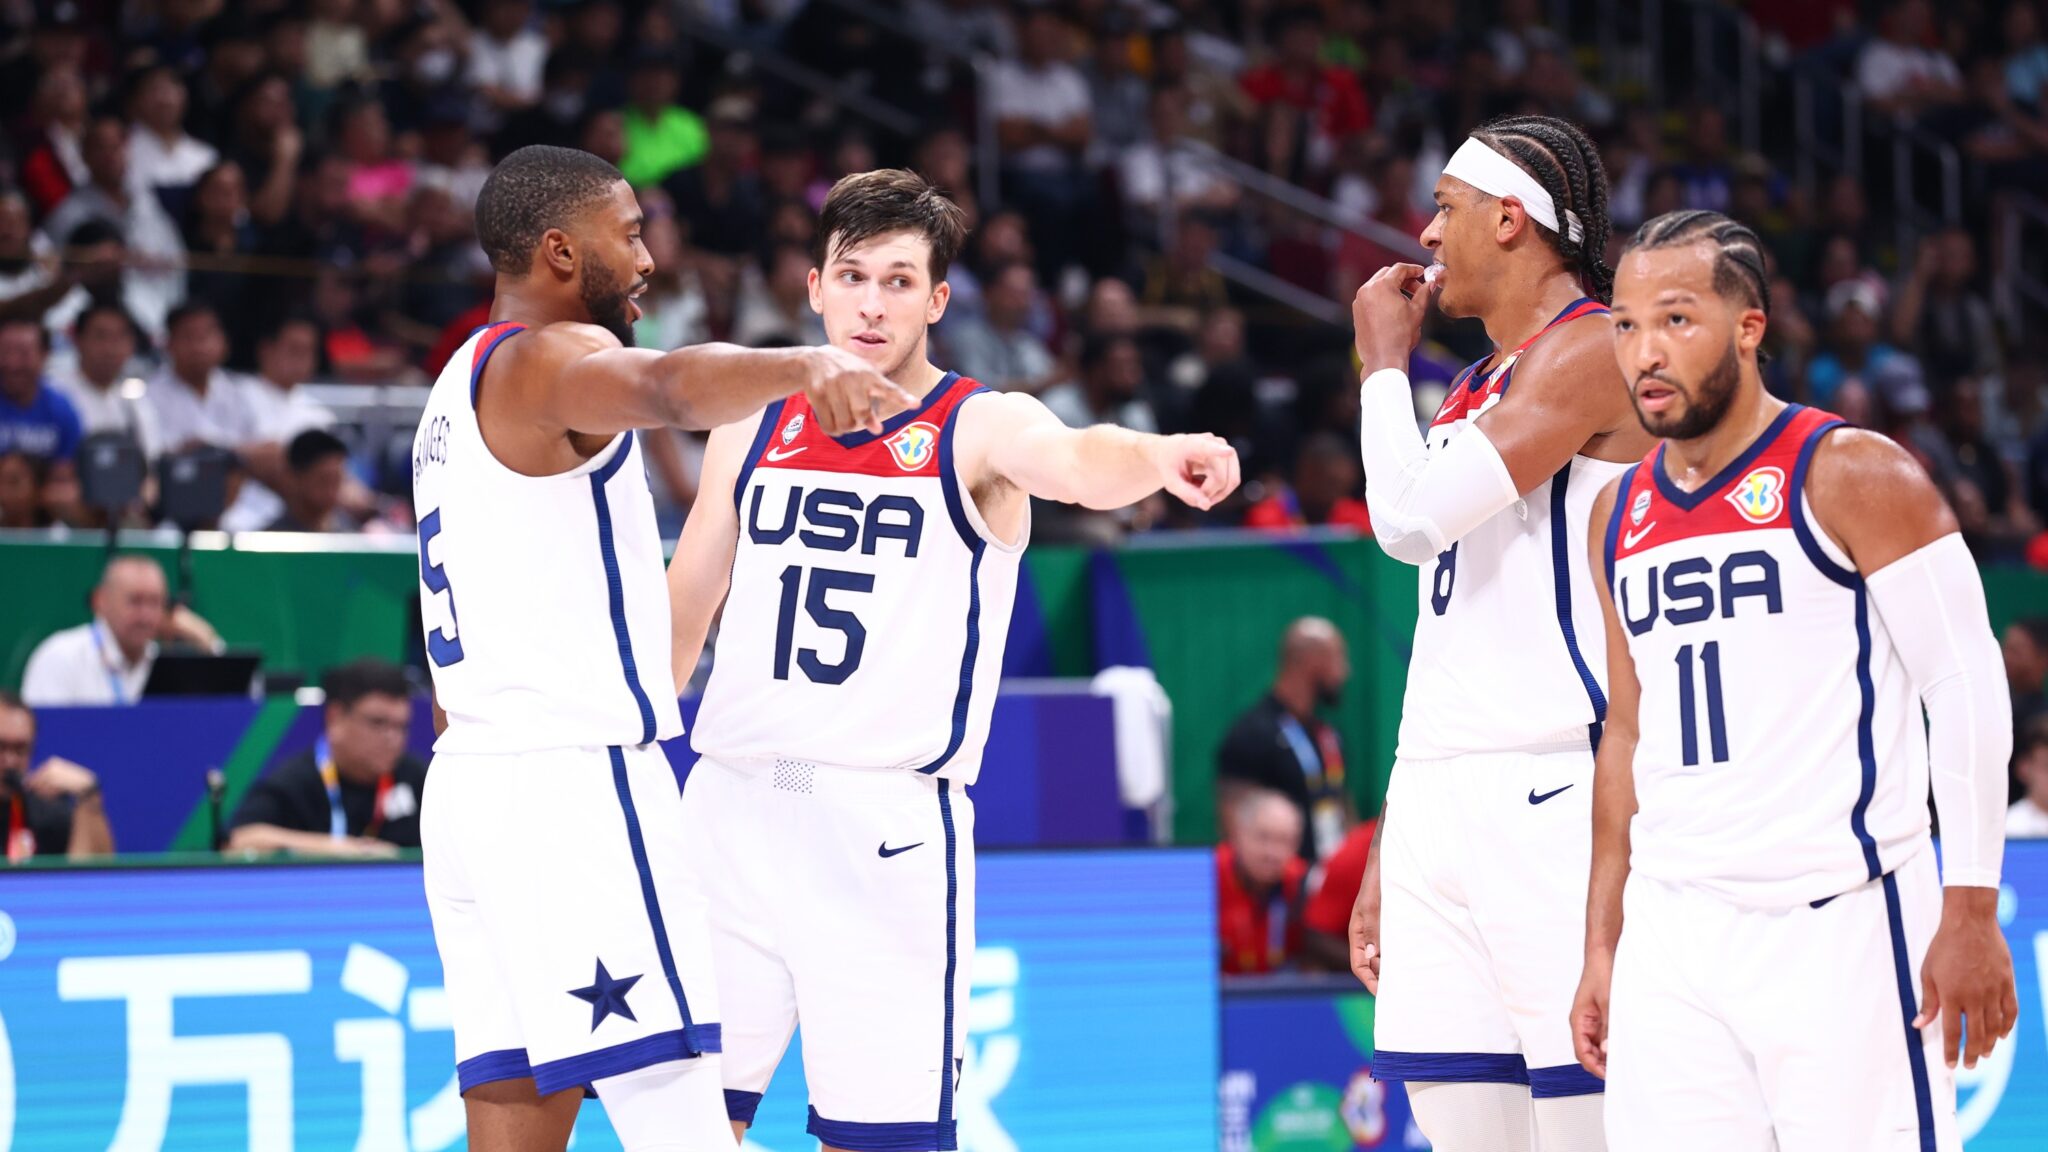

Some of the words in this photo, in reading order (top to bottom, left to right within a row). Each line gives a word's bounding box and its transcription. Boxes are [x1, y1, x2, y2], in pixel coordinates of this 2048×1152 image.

[748, 485, 925, 558] USA
[418, 507, 464, 668] 5
[773, 565, 876, 685] 15
[1620, 550, 1783, 637] USA
[1674, 640, 1729, 767] 11
